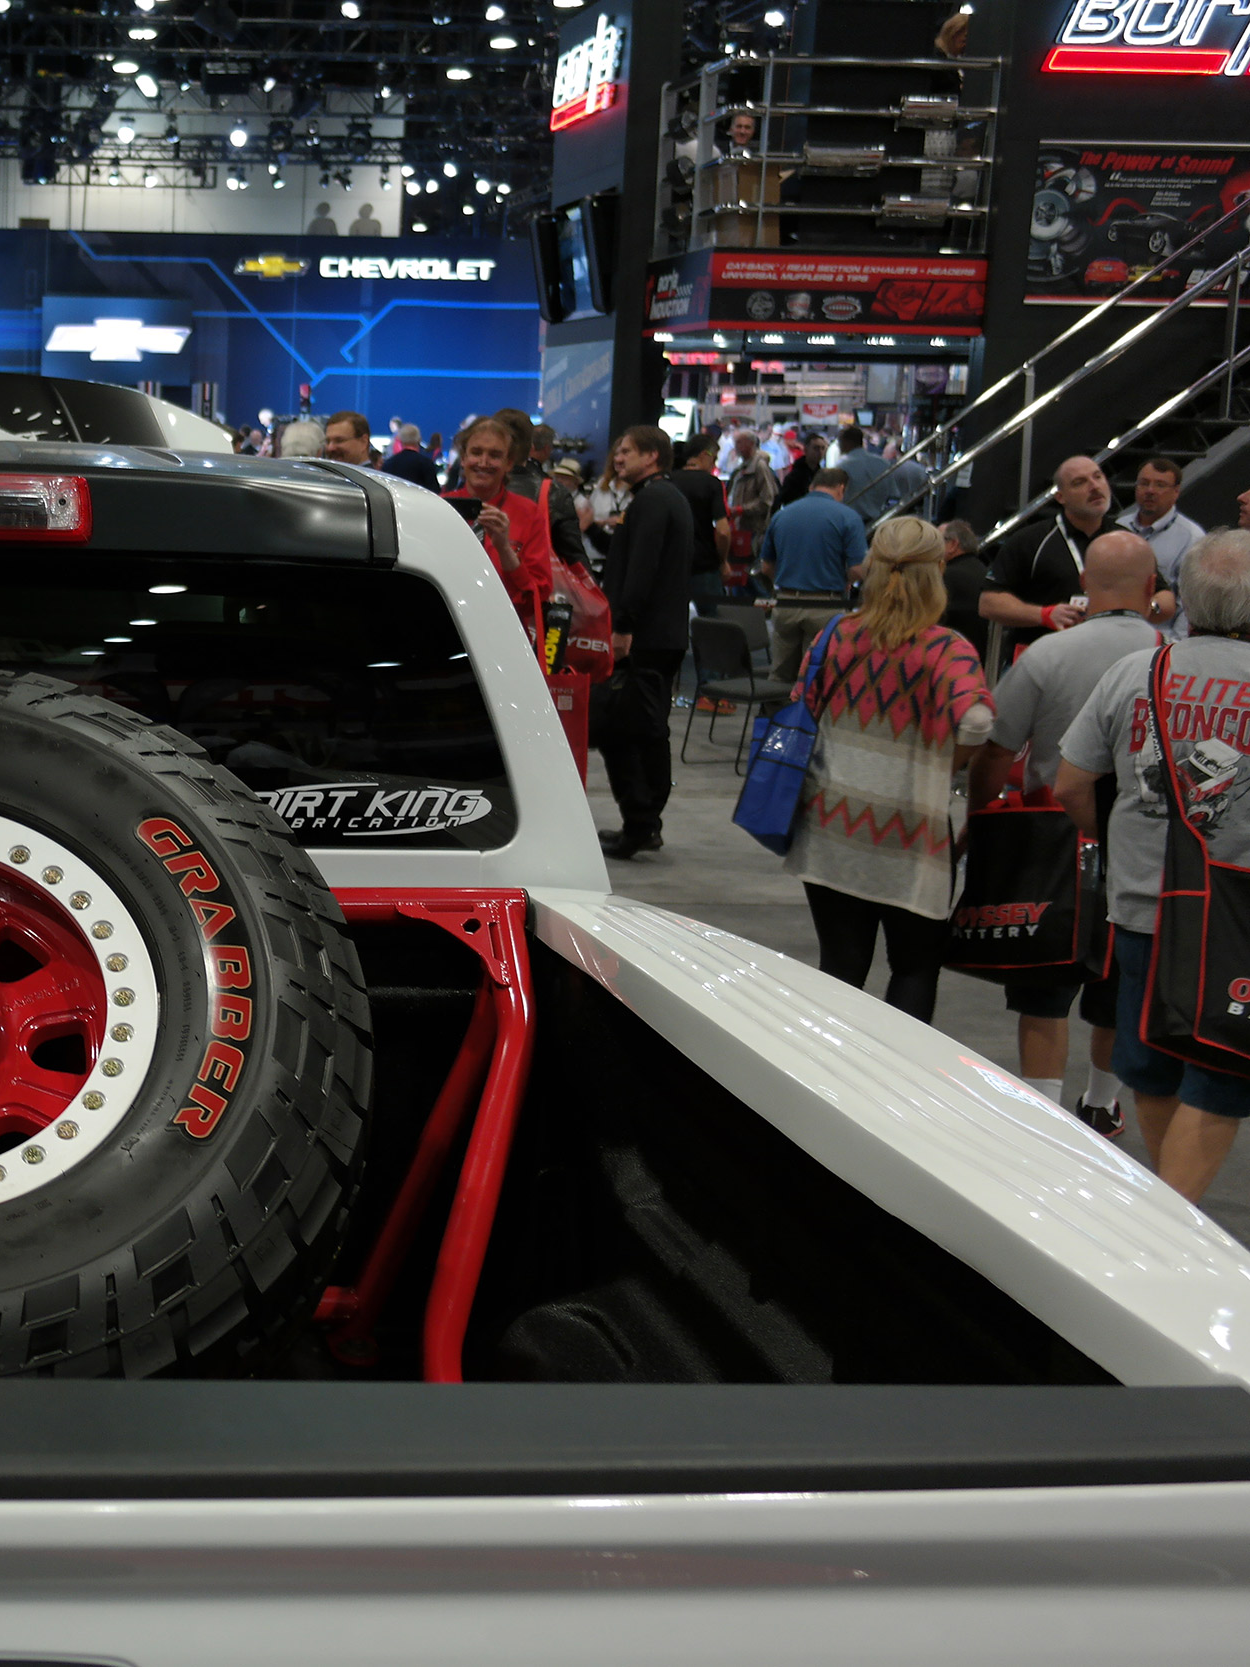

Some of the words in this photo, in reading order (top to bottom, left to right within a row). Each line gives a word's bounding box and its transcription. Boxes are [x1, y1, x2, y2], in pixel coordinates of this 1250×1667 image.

[1079, 151, 1102, 166] The
[1101, 152, 1162, 171] Power
[1160, 156, 1176, 169] of
[1175, 155, 1235, 175] Sound
[318, 256, 497, 281] CHEVROLET
[721, 271, 778, 281] UNIVERSAL
[780, 272, 833, 282] MUFFLERS
[846, 274, 869, 283] TIPS
[817, 264, 861, 274] SECTION
[863, 265, 917, 275] EXHAUSTS
[926, 267, 976, 276] HEADERS
[1164, 672, 1250, 709] ELITE
[364, 789, 484, 818] KING
[290, 817, 462, 829] BRICATION
[136, 817, 253, 1139] GRABBER
